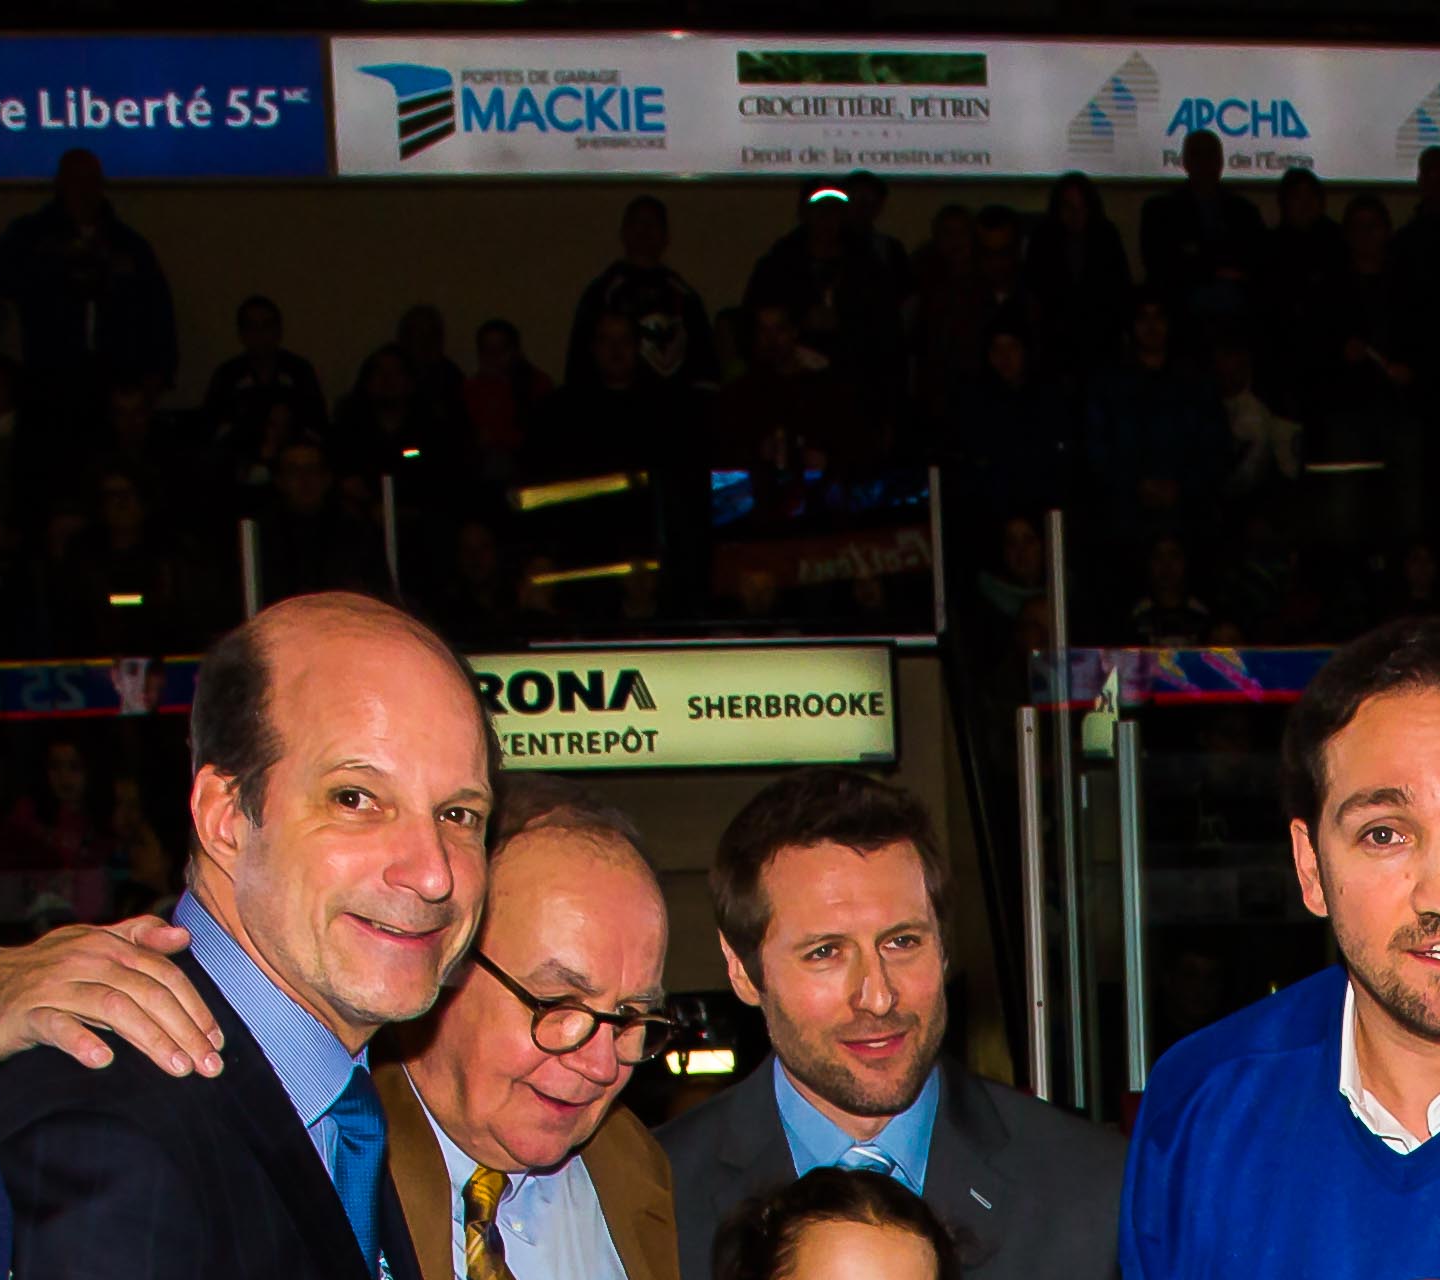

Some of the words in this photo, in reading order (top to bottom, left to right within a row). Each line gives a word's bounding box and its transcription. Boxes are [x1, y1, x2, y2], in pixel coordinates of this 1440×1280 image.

[40, 86, 213, 129] Liberté
[462, 86, 667, 132] MACKIE
[799, 146, 826, 165] de
[687, 691, 886, 720] SHERBROOKE
